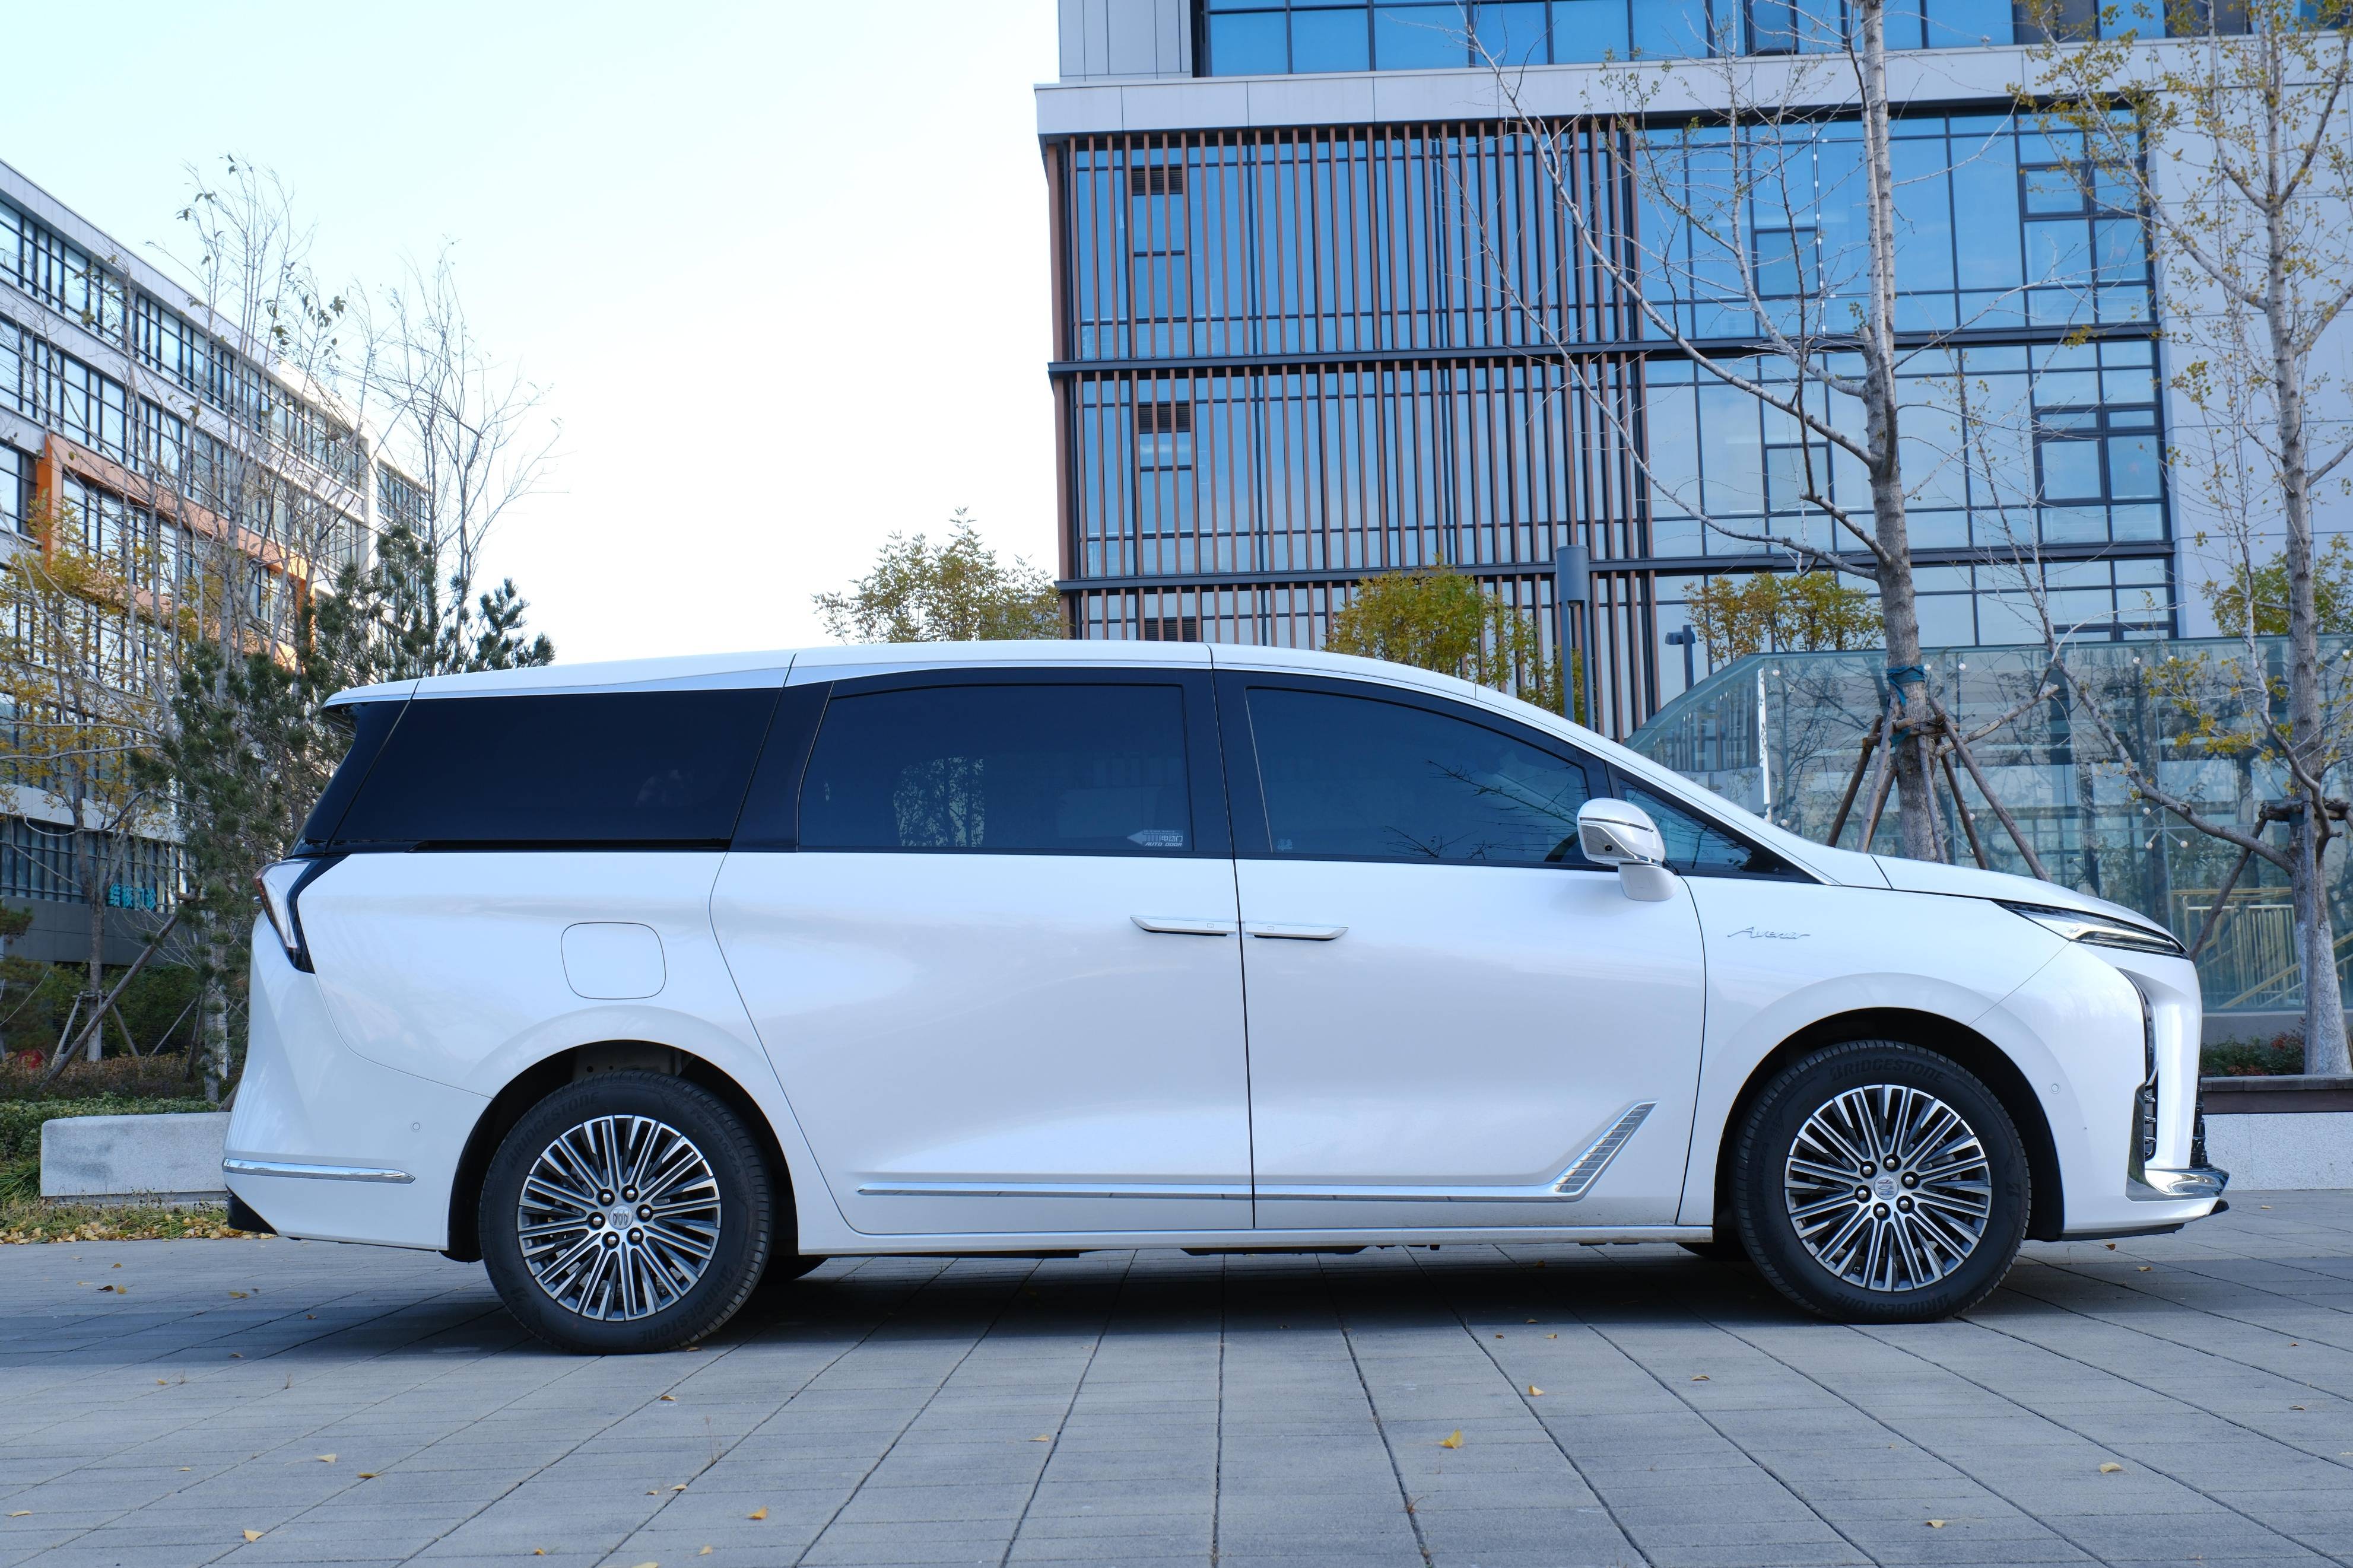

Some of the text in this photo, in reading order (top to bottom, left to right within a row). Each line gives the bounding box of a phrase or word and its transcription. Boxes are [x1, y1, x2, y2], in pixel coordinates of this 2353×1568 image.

[1830, 1058, 1946, 1083] BRIDGESTONE
[506, 1092, 599, 1169] BRIDGESTONE
[639, 1265, 734, 1343] BRIDGESTONE
[1833, 1292, 1952, 1316] BRIDGESTONE
